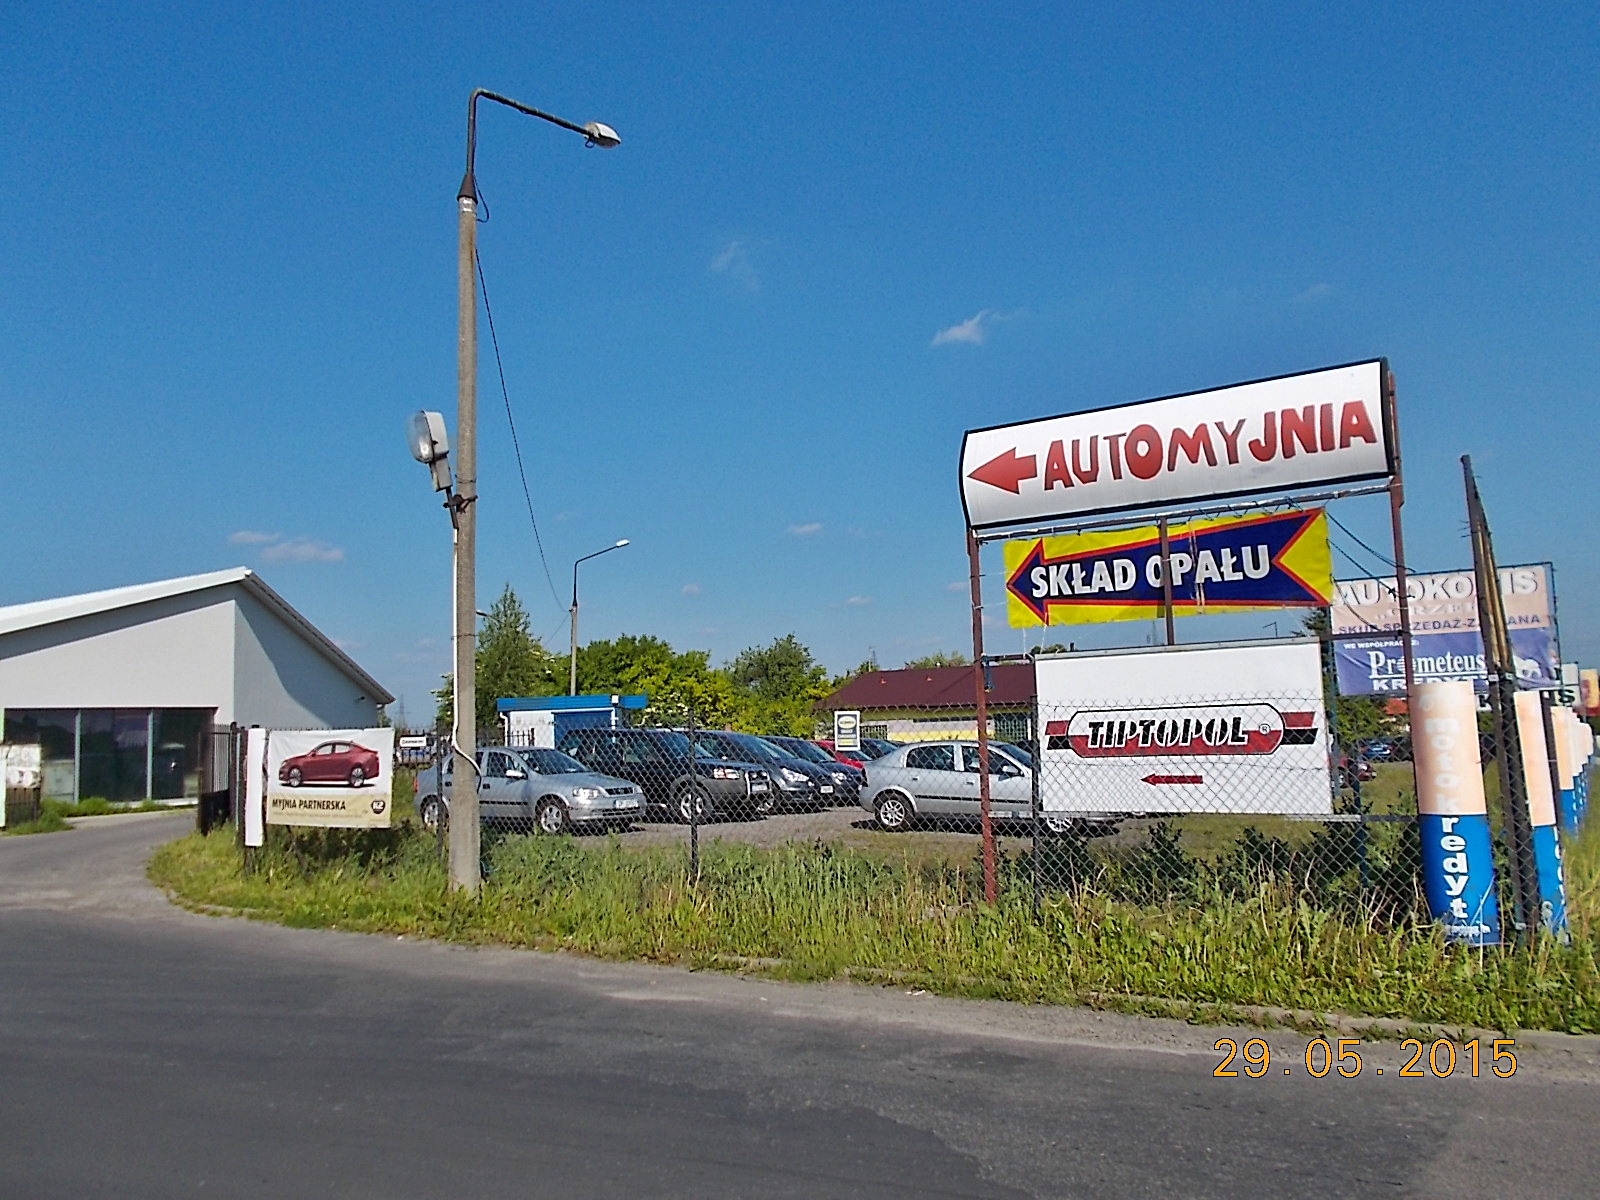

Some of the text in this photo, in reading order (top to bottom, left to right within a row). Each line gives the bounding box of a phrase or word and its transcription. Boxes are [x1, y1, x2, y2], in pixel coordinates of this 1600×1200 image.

[1044, 400, 1378, 491] AUTOMYJNIA
[1031, 544, 1270, 598] SKŁAD OPAŁU
[1332, 570, 1538, 605] AUTOKOIS
[1358, 640, 1406, 648] WSPÓŁPRAC
[1367, 650, 1486, 678] Prometeus
[1087, 716, 1248, 748] TIPTOPOL
[272, 798, 346, 811] MYJNIA PARTNERSKA
